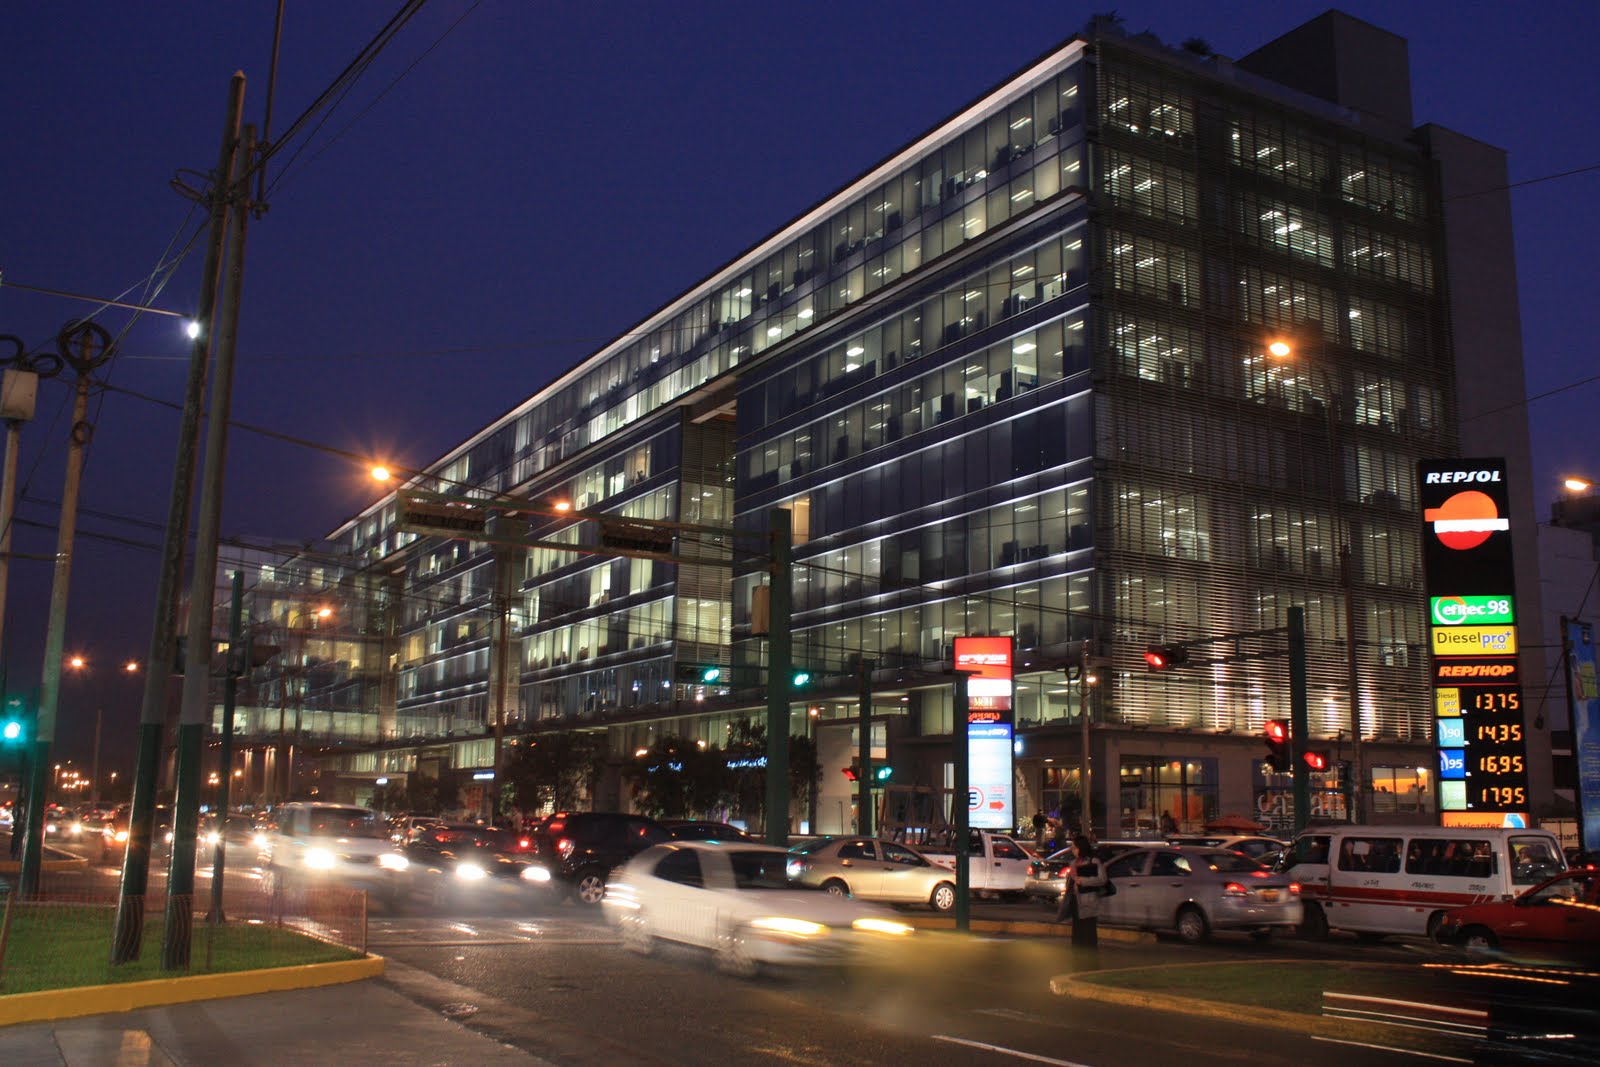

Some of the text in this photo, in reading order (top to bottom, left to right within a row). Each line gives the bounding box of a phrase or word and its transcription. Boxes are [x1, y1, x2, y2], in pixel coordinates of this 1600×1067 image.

[1426, 470, 1501, 484] REPSOL
[1442, 599, 1510, 616] efitec 98
[1438, 665, 1515, 677] REPSHOP
[1475, 693, 1519, 712] 13.75
[1447, 728, 1461, 738] 90
[1478, 725, 1522, 744] 14.35
[1448, 758, 1463, 769] 95
[1480, 756, 1525, 775] 16.95
[1482, 787, 1525, 807] 17.95
